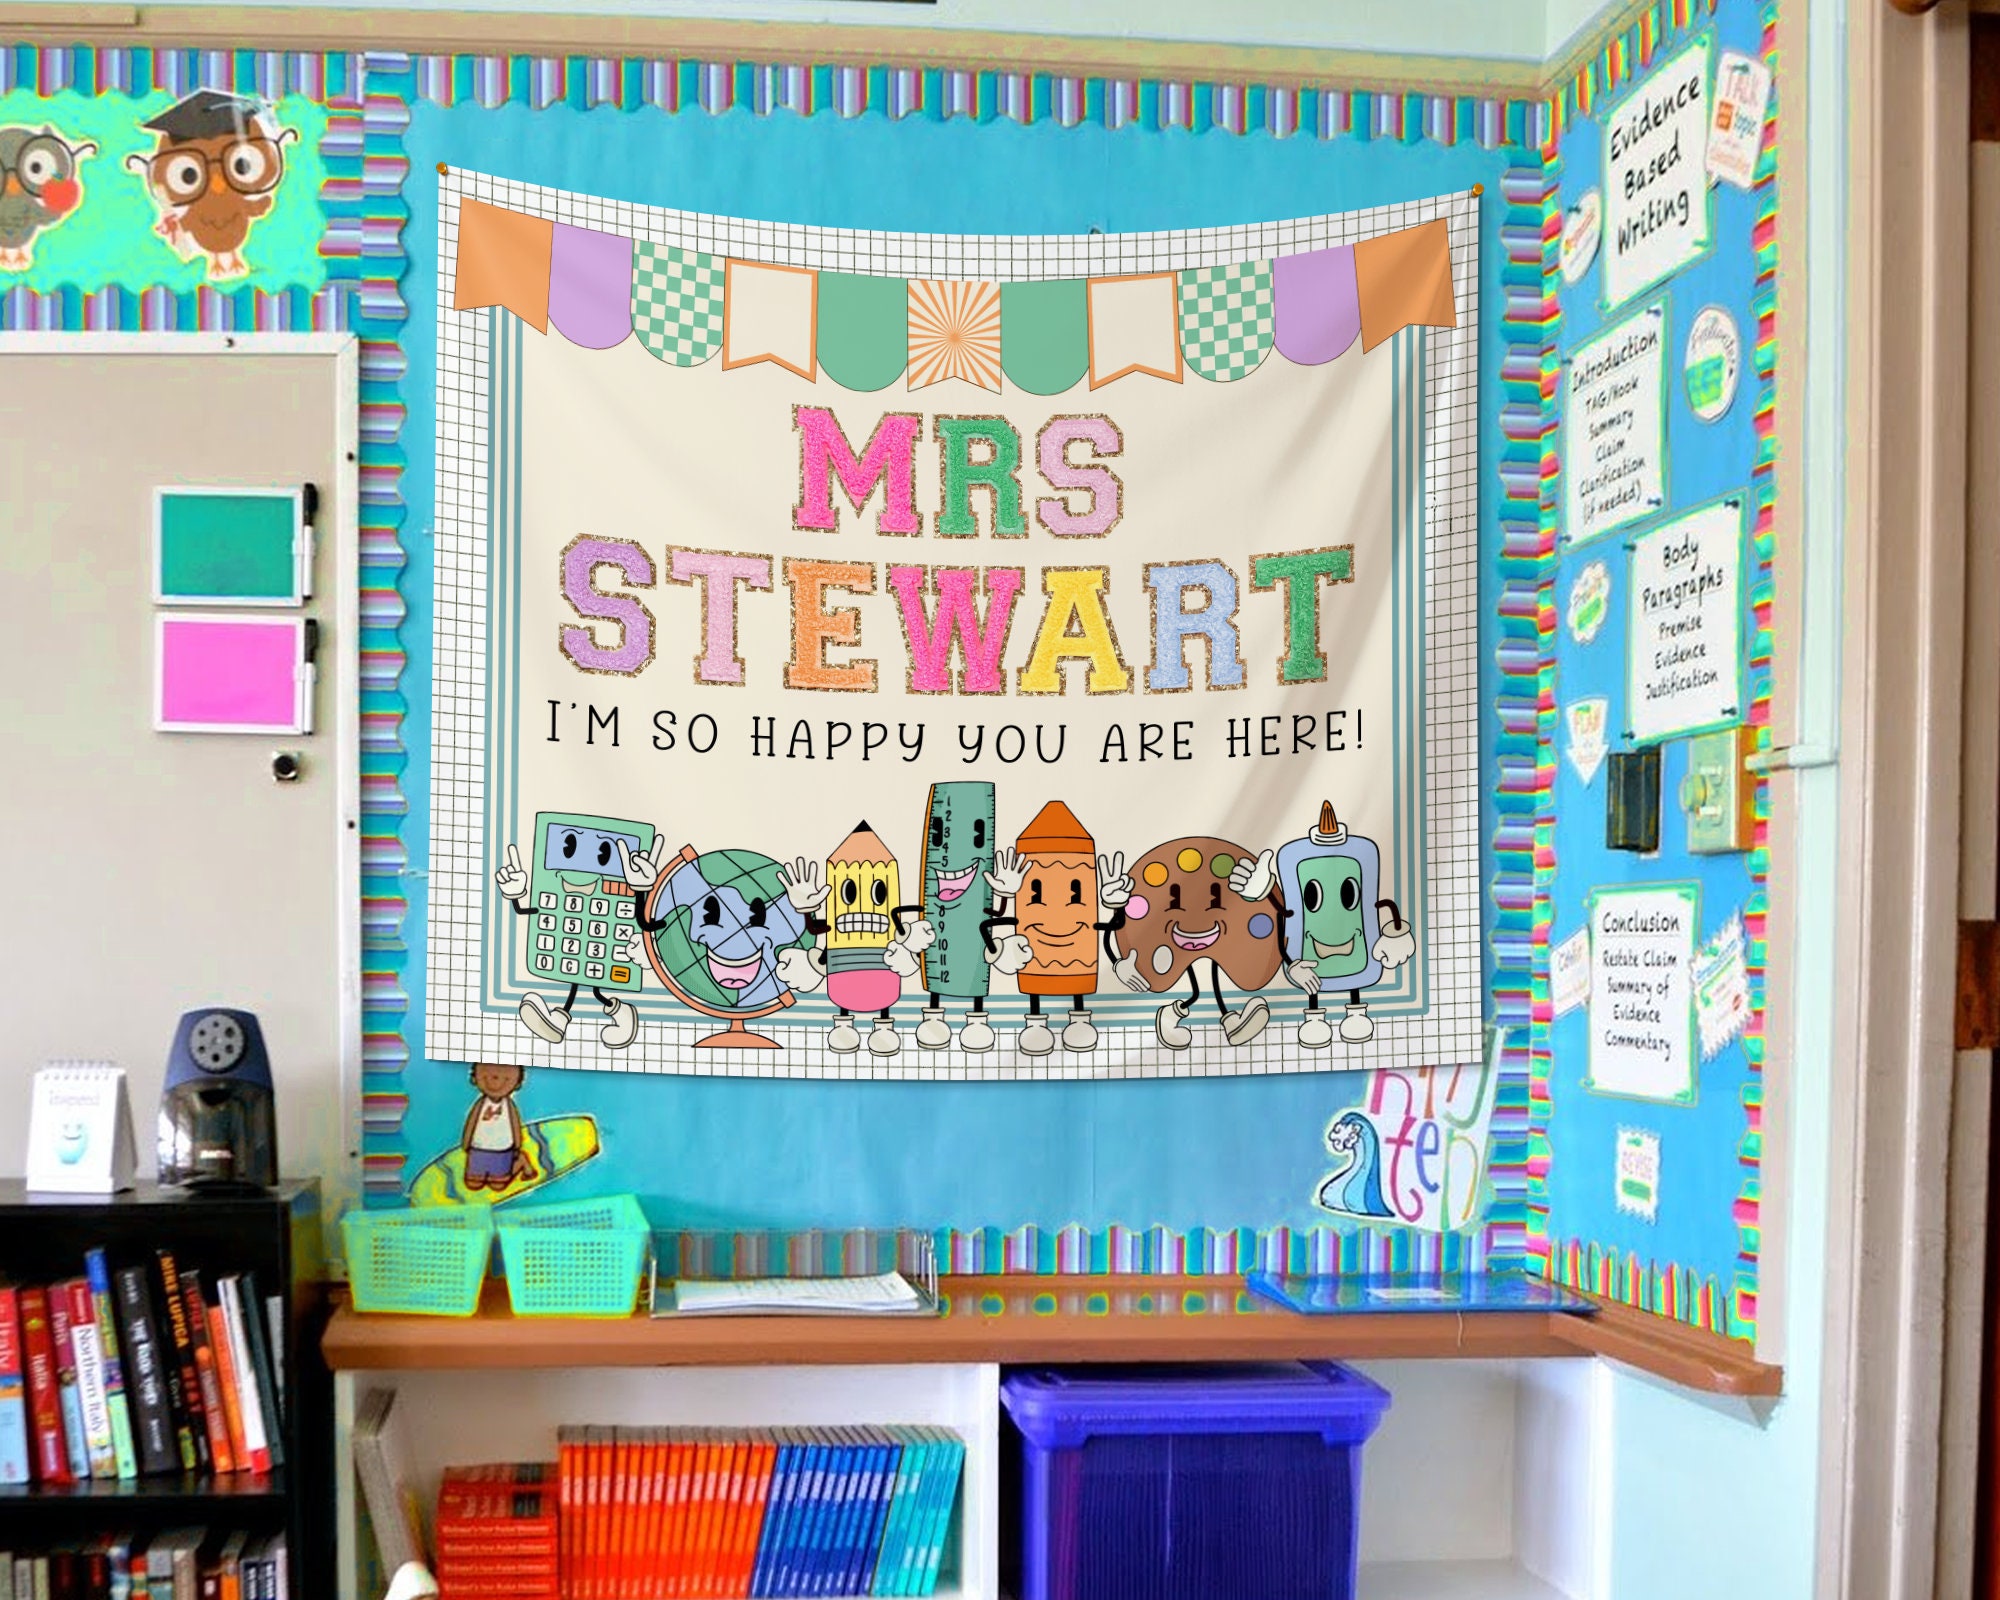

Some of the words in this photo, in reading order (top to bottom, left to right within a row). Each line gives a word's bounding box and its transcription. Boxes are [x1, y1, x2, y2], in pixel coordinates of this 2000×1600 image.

[1610, 76, 1700, 162] Evidence
[1624, 128, 1682, 199] Based
[1617, 190, 1690, 255] Writing
[1572, 331, 1659, 392] Introduction
[1585, 376, 1639, 415] TAG/Hook
[1588, 408, 1634, 442] Summary
[1595, 437, 1625, 463] Claim
[792, 403, 1124, 540] MRS
[1579, 456, 1646, 498] Clarification
[1598, 479, 1642, 516] needed)
[1662, 533, 1699, 571] Body
[1642, 565, 1724, 611] Paragraphs
[559, 532, 1355, 697] STEWART
[1658, 612, 1703, 641] Premise
[1654, 642, 1706, 670] Evidence
[1646, 669, 1719, 701] Justification
[547, 699, 620, 747] I'M
[652, 710, 718, 753] SO
[750, 716, 926, 763] HAPPY
[958, 724, 1067, 764] YOU
[1100, 721, 1194, 763] ARE
[1226, 709, 1364, 758] HERE!
[945, 810, 952, 822] 2
[946, 796, 951, 807] 1
[942, 842, 949, 854] 4
[944, 827, 951, 838] 3
[941, 855, 949, 867] 5
[545, 895, 551, 907] 7
[570, 897, 577, 910] 8
[596, 901, 603, 913] 9
[542, 916, 550, 928] 4
[568, 919, 576, 932] 5
[594, 923, 601, 935] 6
[938, 921, 945, 933] 9
[1602, 911, 1680, 934] Conclusion
[567, 940, 575, 952] 2
[592, 944, 600, 956] 3
[938, 939, 948, 951] 10
[940, 954, 947, 966] 11
[1602, 951, 1640, 969] Restate
[1644, 949, 1678, 968] Claim
[940, 971, 950, 983] 12
[1607, 976, 1652, 1005] Summary
[1656, 973, 1670, 996] of
[1613, 1005, 1661, 1024] Evidence
[1604, 1029, 1671, 1062] Commentary
[160, 1256, 178, 1294] MIKE
[52, 1311, 68, 1345] Paris
[167, 1295, 189, 1349] LUPICA
[32, 1353, 49, 1391] Italia
[79, 1327, 100, 1401] Northern
[89, 1402, 105, 1433] Italy
